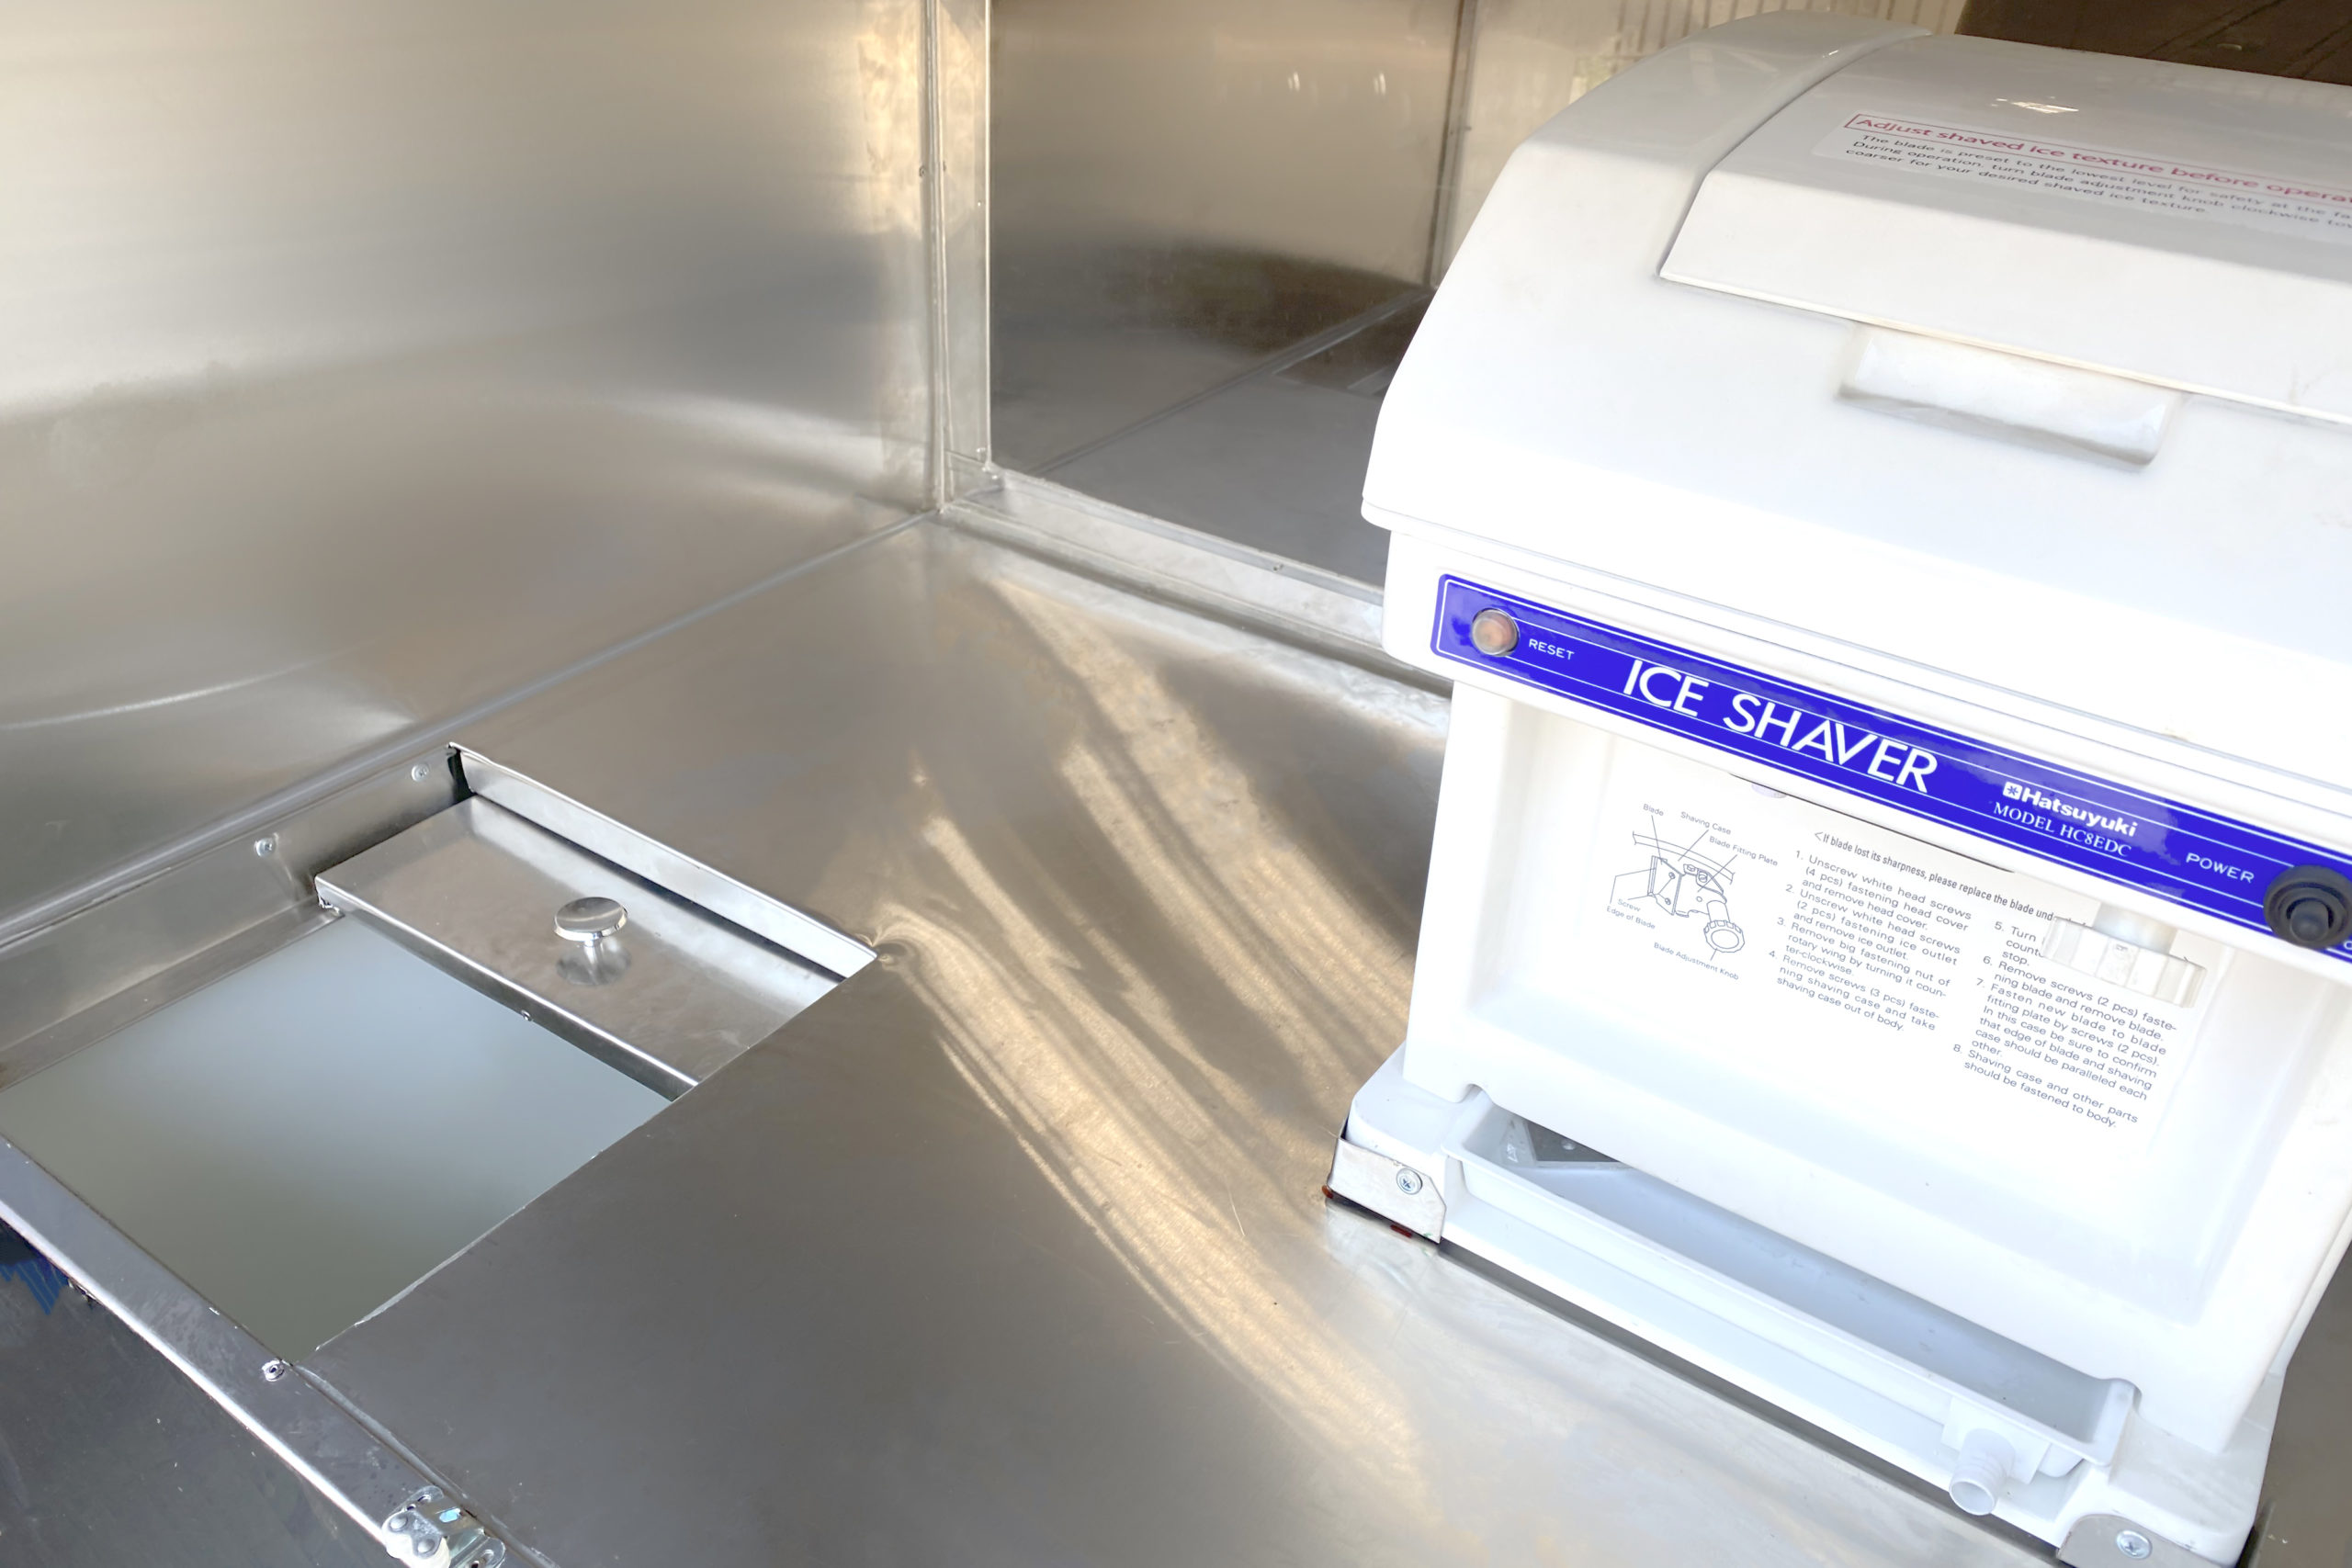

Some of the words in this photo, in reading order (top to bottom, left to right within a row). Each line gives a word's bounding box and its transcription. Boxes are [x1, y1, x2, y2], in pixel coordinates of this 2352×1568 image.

[1845, 149, 1904, 162] coarser
[1909, 158, 1932, 166] for
[1937, 164, 1972, 173] your
[1978, 171, 2040, 185] desired
[2043, 182, 2104, 196] shaved
[2109, 192, 2134, 200] ice
[1852, 141, 1902, 154] During
[1991, 164, 2024, 174] turn
[2030, 170, 2074, 182] blade
[2079, 179, 2174, 198] adjustment
[2181, 194, 2223, 206] knob
[1855, 118, 1933, 136] Adjust
[1936, 132, 2024, 150] shaved
[2029, 145, 2064, 156] ice
[2072, 152, 2164, 172] texture
[2170, 166, 2258, 187] before
[1862, 134, 1888, 143] The
[1894, 140, 1934, 151] blade
[1957, 151, 2008, 163] preset
[2039, 164, 2064, 172] the
[2070, 168, 2124, 182] lowest
[2132, 177, 2172, 189] level
[1528, 637, 1575, 662] RESET
[1623, 660, 1709, 719] ICE
[1723, 692, 1939, 794] SHAVER
[1643, 803, 1664, 816] Blade
[1679, 811, 1710, 828] Shaving
[1712, 822, 1731, 834] Case
[1993, 802, 2055, 833] MODEL
[2060, 824, 2132, 857] HC8EDC
[2021, 787, 2138, 837] Hatsuyuki
[1709, 835, 1730, 848] Blade
[1732, 844, 1757, 859] Fitting
[1758, 853, 1778, 865] Plate
[1829, 836, 1852, 852] blade
[1854, 844, 1870, 858] lost
[1871, 850, 1881, 862] its
[1882, 855, 1927, 879] sharpness,
[1928, 873, 1957, 888] please
[1958, 884, 1992, 900] replace
[1993, 894, 2007, 906] the
[2008, 898, 2034, 914] blade
[2186, 852, 2256, 883] POWER
[1617, 897, 1640, 911] Screw
[1802, 879, 1822, 891] and
[1824, 887, 1864, 907] remove
[1867, 901, 1894, 917] head
[1808, 854, 1857, 878] Unscrew
[1861, 875, 1893, 891] white
[1897, 886, 1926, 903] head
[1929, 899, 1971, 919] screws
[1819, 873, 1842, 886] pcs)
[1848, 881, 1898, 908] fastening
[1903, 901, 1931, 919] head
[1936, 915, 1968, 931] cover
[1606, 905, 1624, 917] Edge
[1634, 916, 1655, 929] Blade
[1792, 912, 1813, 924] and
[1815, 920, 1855, 940] remove
[1857, 936, 1872, 946] ice
[1800, 888, 1848, 912] Unscrew
[1852, 909, 1883, 925] white
[1887, 920, 1915, 937] head
[1919, 934, 1960, 953] screws
[1811, 907, 1836, 921] pcs)
[1840, 916, 1894, 943] fastening
[1899, 940, 1917, 950] ice
[1921, 948, 1957, 965] outlet
[2011, 925, 2036, 942] Turn
[1653, 942, 1674, 954] Blade
[1675, 951, 1717, 972] Adjustment
[1719, 967, 1738, 980] Knob
[1788, 934, 1817, 951] rotary
[1821, 946, 1846, 962] wing
[1849, 955, 1862, 967] by
[1865, 963, 1902, 983] turning
[1916, 982, 1946, 997] coun-
[1791, 921, 1835, 944] Remove
[1838, 940, 1856, 953] big
[1860, 947, 1910, 974] fastening
[1915, 969, 1933, 981] nut
[1938, 978, 1951, 987] of
[2001, 951, 2029, 966] stop.
[1777, 977, 1815, 998] shaving
[1817, 993, 1841, 1006] case
[1844, 1003, 1860, 1014] out
[1863, 1010, 1875, 1019] of
[1876, 1013, 1903, 1031] body.
[1779, 966, 1803, 981] ning
[1807, 977, 1849, 998] shaving
[1854, 995, 1880, 1009] case
[1884, 1007, 1906, 1019] and
[1911, 1015, 1935, 1030] take
[1782, 953, 1825, 976] Remove
[1828, 973, 1866, 991] screws
[1883, 994, 1905, 1007] pcs)
[1909, 1001, 1939, 1018] faste-
[1994, 974, 2018, 988] ning
[2020, 981, 2052, 998] blade
[2054, 996, 2078, 1008] and
[2079, 1004, 2125, 1025] remove
[2128, 1020, 2162, 1041] blade.
[1997, 960, 2046, 984] Remove
[2050, 980, 2093, 1000] screws
[2111, 1003, 2138, 1018] pcs)
[2142, 1012, 2176, 1030] faste-
[1971, 1040, 2002, 1056] other.
[1986, 994, 2019, 1013] fitting
[2021, 1009, 2050, 1023] plate
[2052, 1019, 2068, 1031] by
[2070, 1027, 2114, 1047] screws
[2131, 1050, 2159, 1066] pcs).
[1990, 983, 2032, 1005] Fasten
[2038, 1001, 2065, 1016] new
[2070, 1011, 2106, 1032] blade
[2111, 1028, 2124, 1039] to
[2130, 1034, 2165, 1055] blade
[1997, 1011, 2017, 1024] this
[2020, 1021, 2046, 1034] case
[2050, 1030, 2064, 1042] be
[2067, 1039, 2093, 1053] sure
[2097, 1049, 2109, 1058] to
[2112, 1055, 2156, 1077] confirm
[1975, 1029, 2000, 1043] case
[2003, 1040, 2041, 1058] should
[2043, 1053, 2058, 1065] be
[2061, 1062, 2117, 1088] paralleled
[2119, 1085, 2146, 1100] each
[1979, 1017, 2000, 1031] that
[2003, 1027, 2031, 1042] edge
[2034, 1039, 2047, 1047] of
[2049, 1042, 2079, 1060] blade
[2082, 1057, 2105, 1070] and
[2107, 1066, 2152, 1090] shaving
[1964, 1062, 2001, 1080] should
[2002, 1075, 2017, 1087] be
[2020, 1082, 2070, 1108] fastened
[2072, 1103, 2083, 1113] to
[2086, 1108, 2115, 1127] body.
[1967, 1049, 2011, 1074] Shaving
[2016, 1069, 2041, 1084] case
[2046, 1082, 2068, 1095] and
[2072, 1092, 2104, 1108] other
[2107, 1106, 2138, 1122] parts
